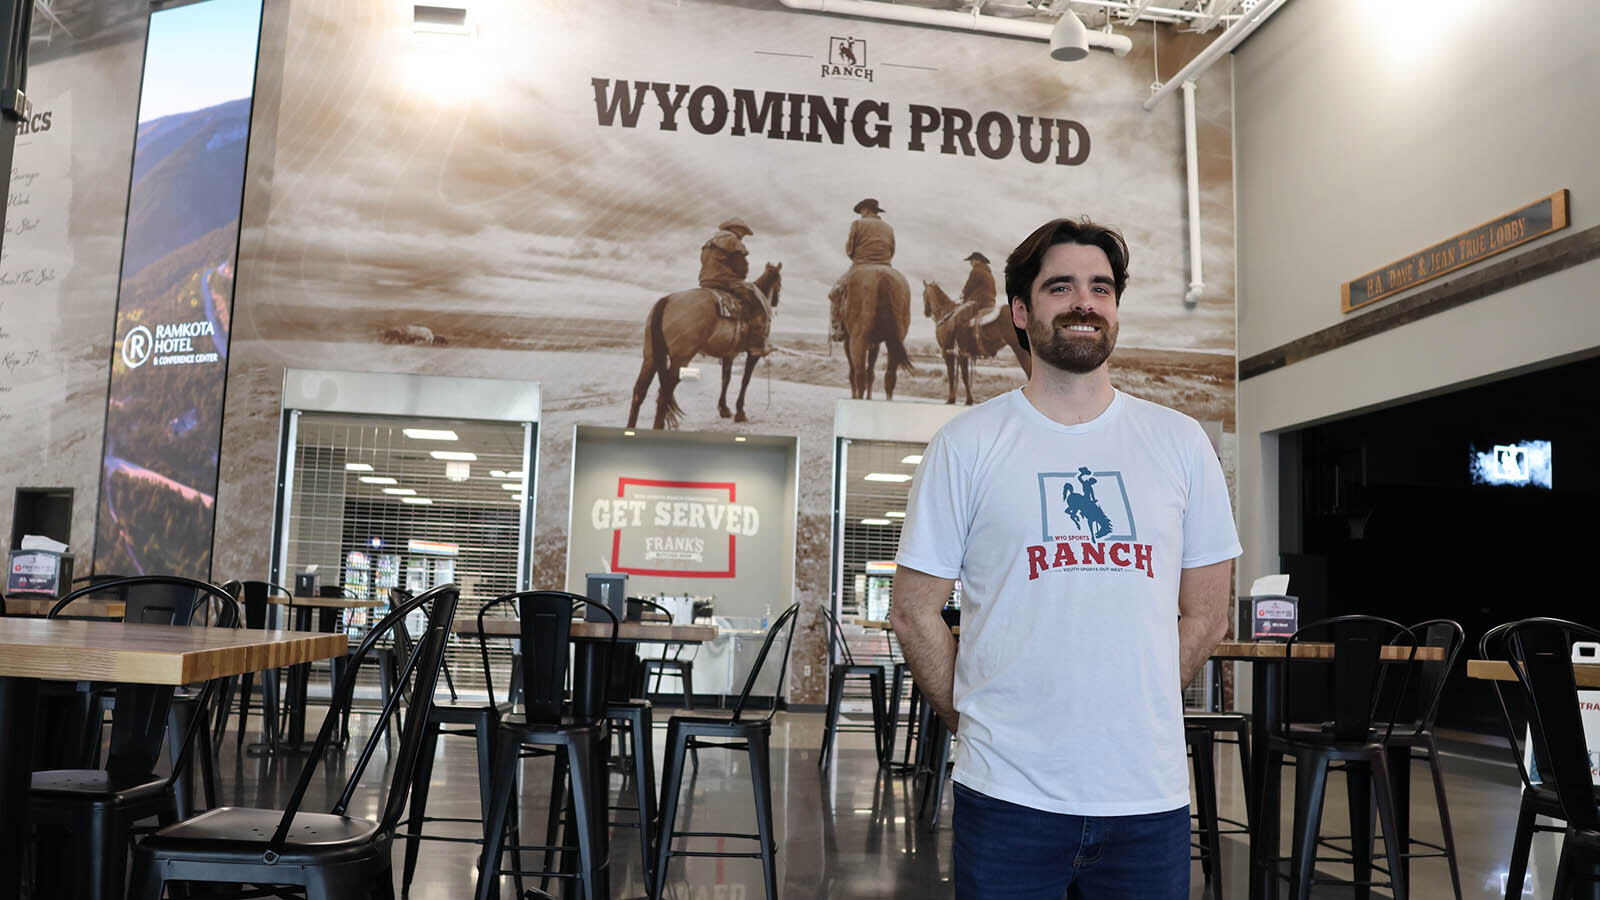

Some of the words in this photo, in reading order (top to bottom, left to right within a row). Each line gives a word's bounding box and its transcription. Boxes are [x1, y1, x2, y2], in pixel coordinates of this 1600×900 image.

[821, 64, 873, 82] RANCH
[591, 77, 892, 149] WYOMING
[908, 103, 1092, 167] PROUD
[1458, 234, 1485, 261] TRUE
[1489, 216, 1526, 248] LOBBY
[155, 321, 215, 339] RAMKOTA
[154, 338, 194, 354] HOTEL
[159, 354, 195, 365] CONFERENCE
[195, 352, 219, 363] CENTER
[591, 498, 647, 531] GET
[653, 500, 760, 536] SERVED
[645, 535, 705, 553] FRANK'S
[1026, 542, 1154, 581] RANCH
